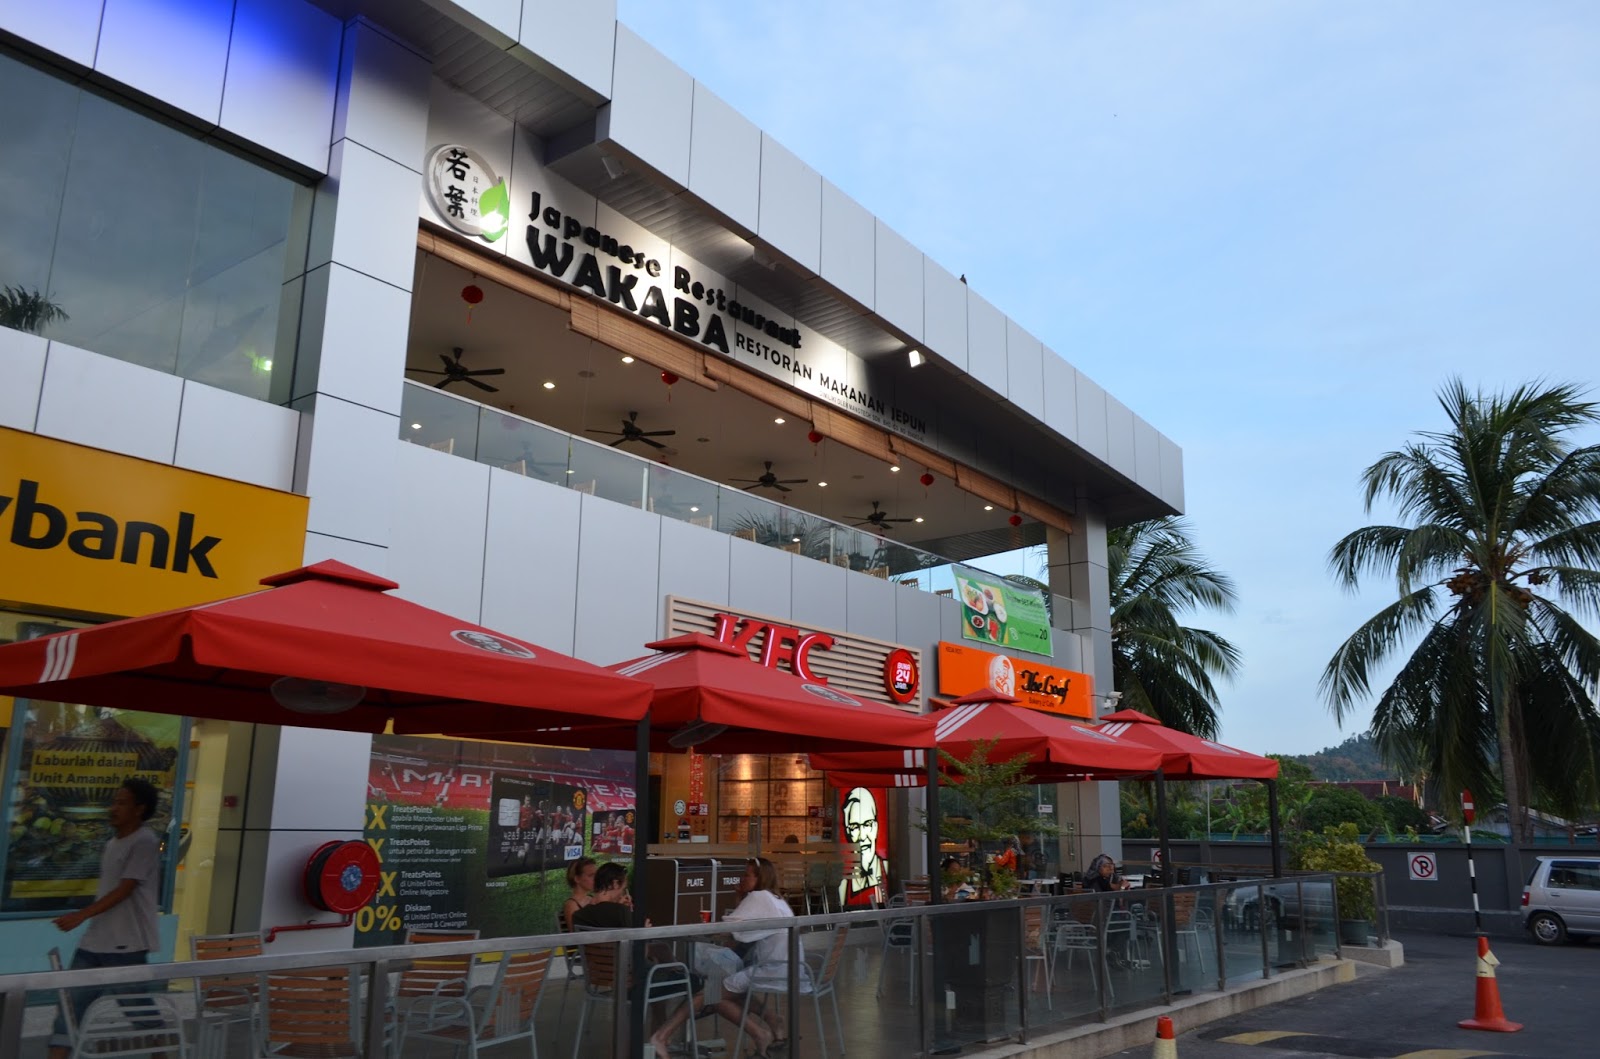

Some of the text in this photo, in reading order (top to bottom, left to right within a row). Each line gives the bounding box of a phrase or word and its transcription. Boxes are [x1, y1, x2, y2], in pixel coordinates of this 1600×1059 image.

[528, 191, 802, 349] Japanese Restaurant
[526, 225, 730, 354] WAKABA
[736, 332, 926, 434] RESTORAN MAKANAN JEPUN
[714, 613, 828, 685] KFC
[896, 669, 910, 683] 24
[1020, 669, 1043, 692] The
[97, 756, 135, 767] dalam
[33, 771, 62, 783] Unit
[65, 773, 120, 785] Amanah
[392, 806, 433, 814] TreatsPoints
[391, 824, 424, 832] memenangi
[456, 824, 467, 832] Liga
[389, 838, 430, 846] TreatsPoints
[567, 848, 581, 857] VISA
[379, 871, 398, 897] X
[401, 871, 441, 879] TreatsPoints
[427, 879, 444, 887] Direct
[686, 878, 704, 887] PLATE
[722, 876, 741, 885] TRASH
[420, 889, 449, 897] Megastore
[405, 904, 431, 912] Diskaun
[403, 921, 433, 929] Megastore
